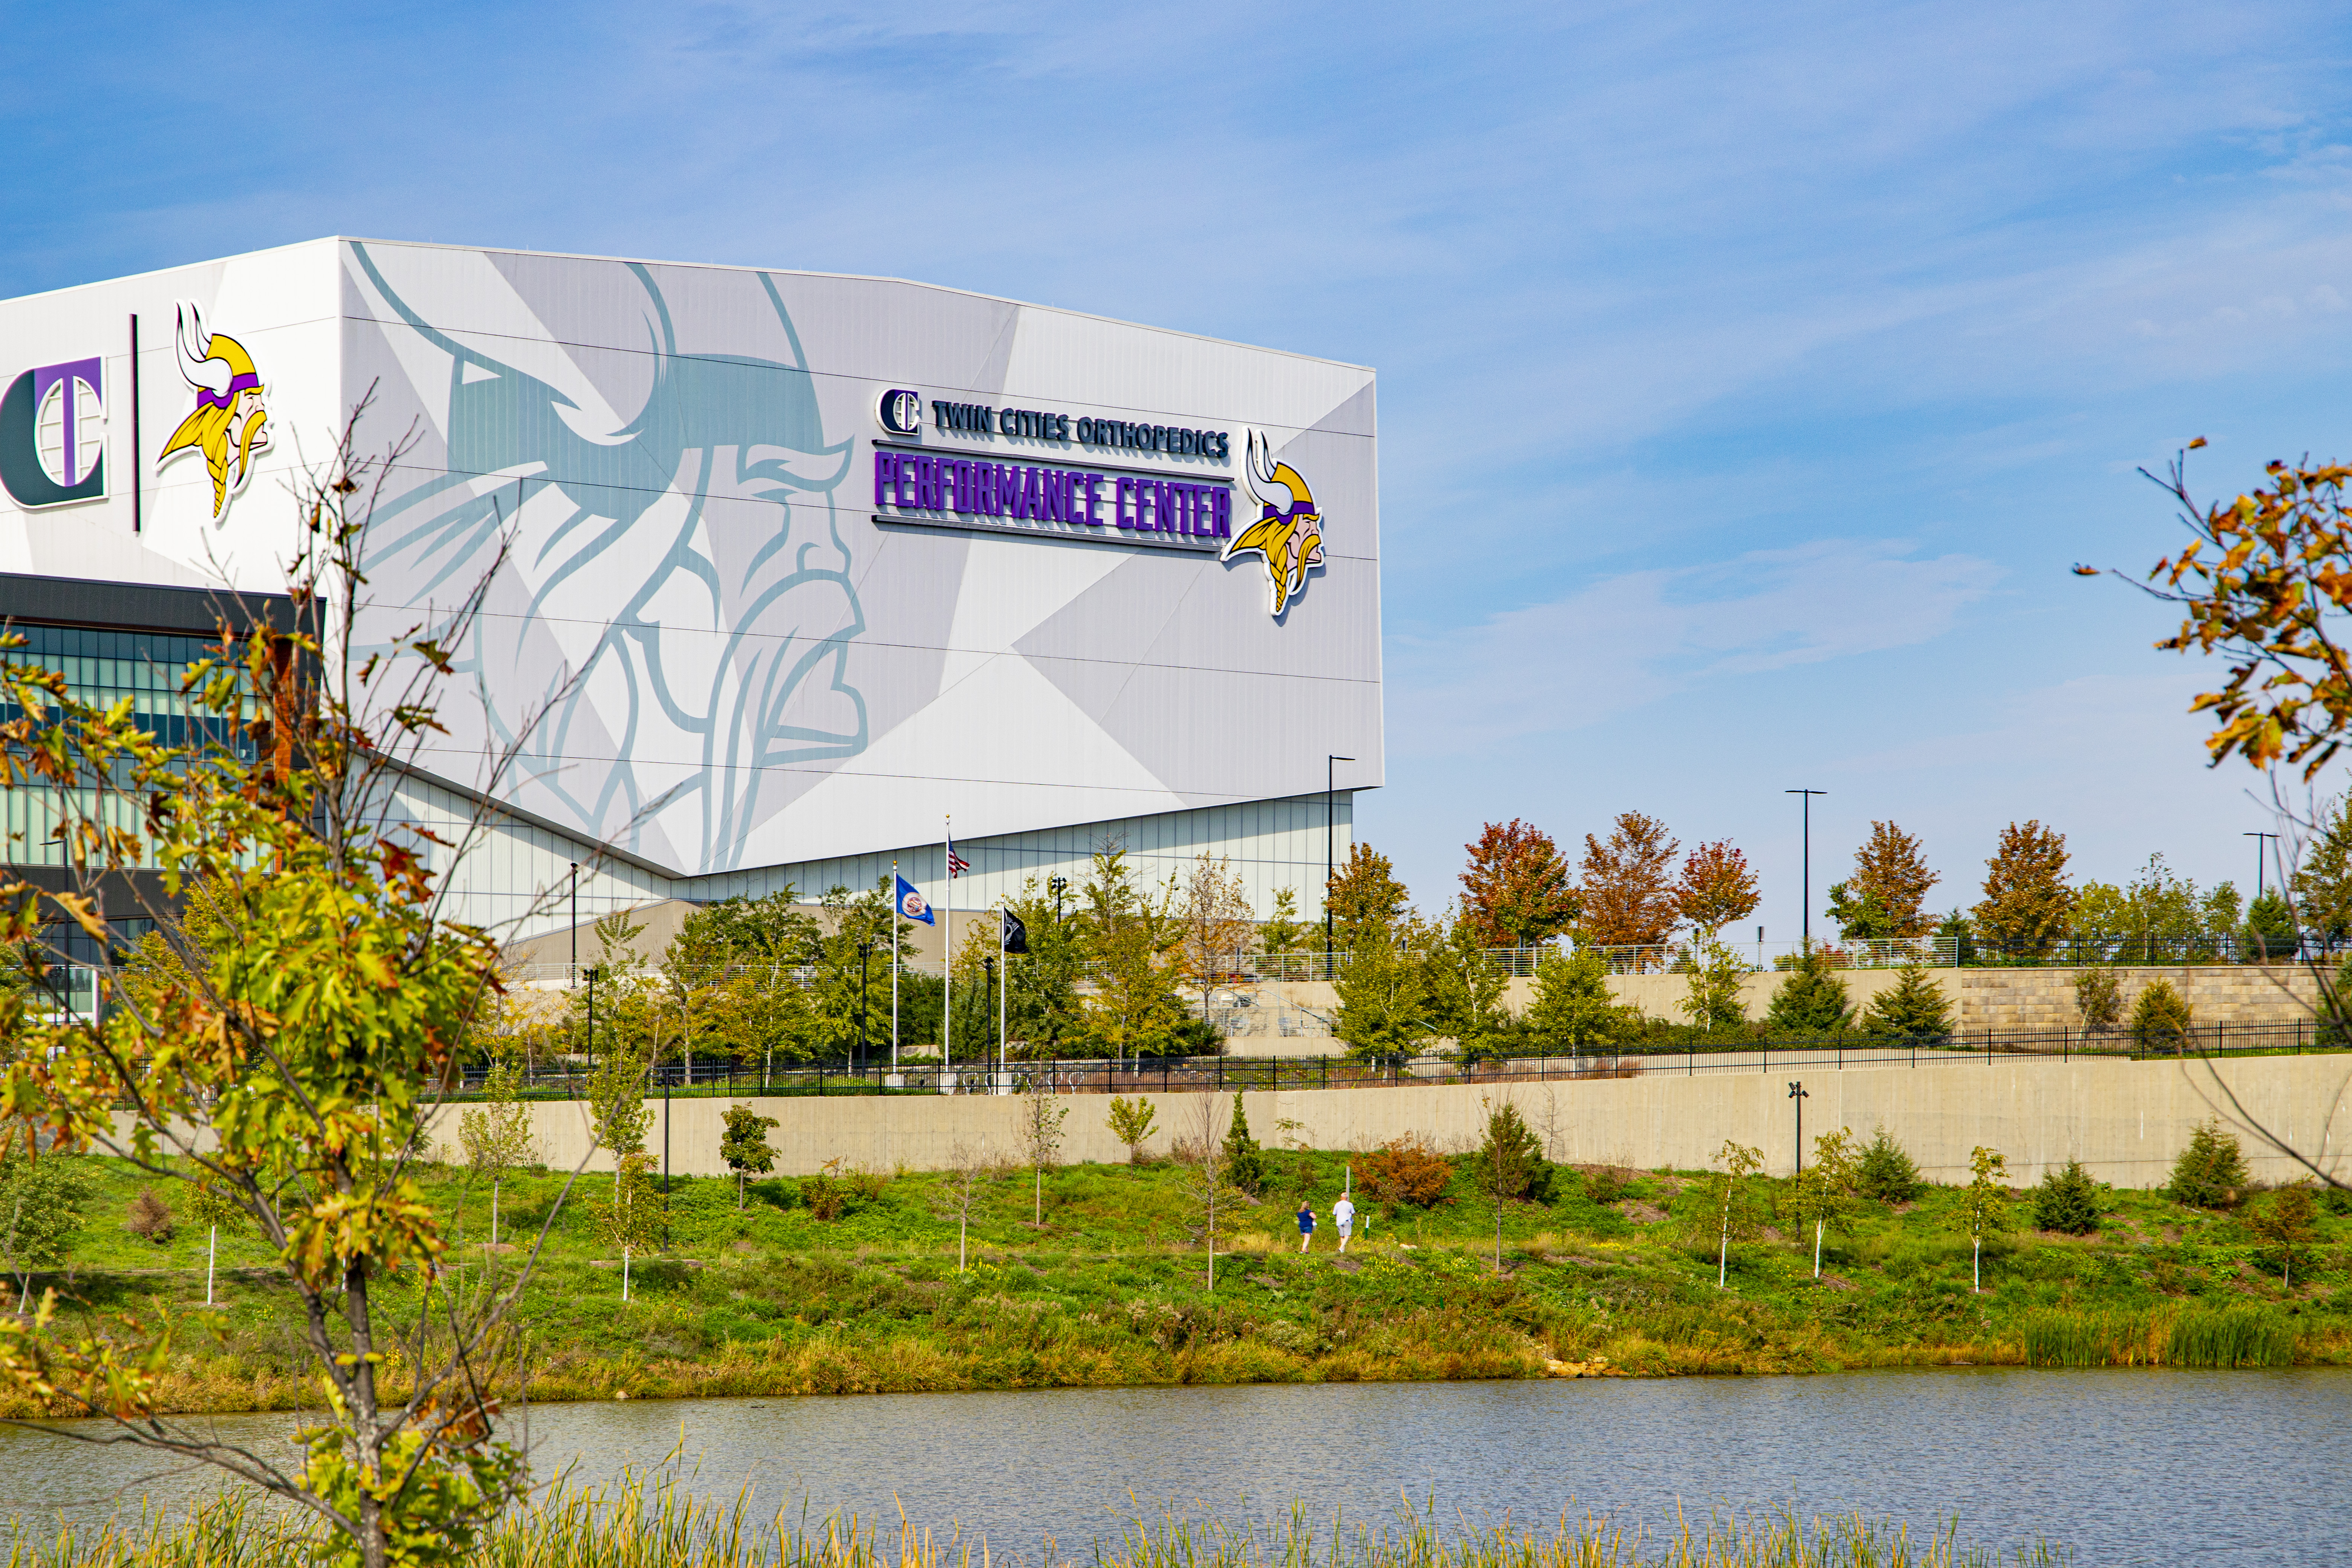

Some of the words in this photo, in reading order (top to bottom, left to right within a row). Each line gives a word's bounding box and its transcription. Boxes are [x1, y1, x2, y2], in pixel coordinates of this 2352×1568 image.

[932, 400, 992, 432] TWIN
[1000, 408, 1069, 440] CITIES
[1077, 416, 1228, 458] ORTHOPEDICS
[875, 452, 1104, 526] PERFORMANCE
[1116, 477, 1231, 538] CENTER
